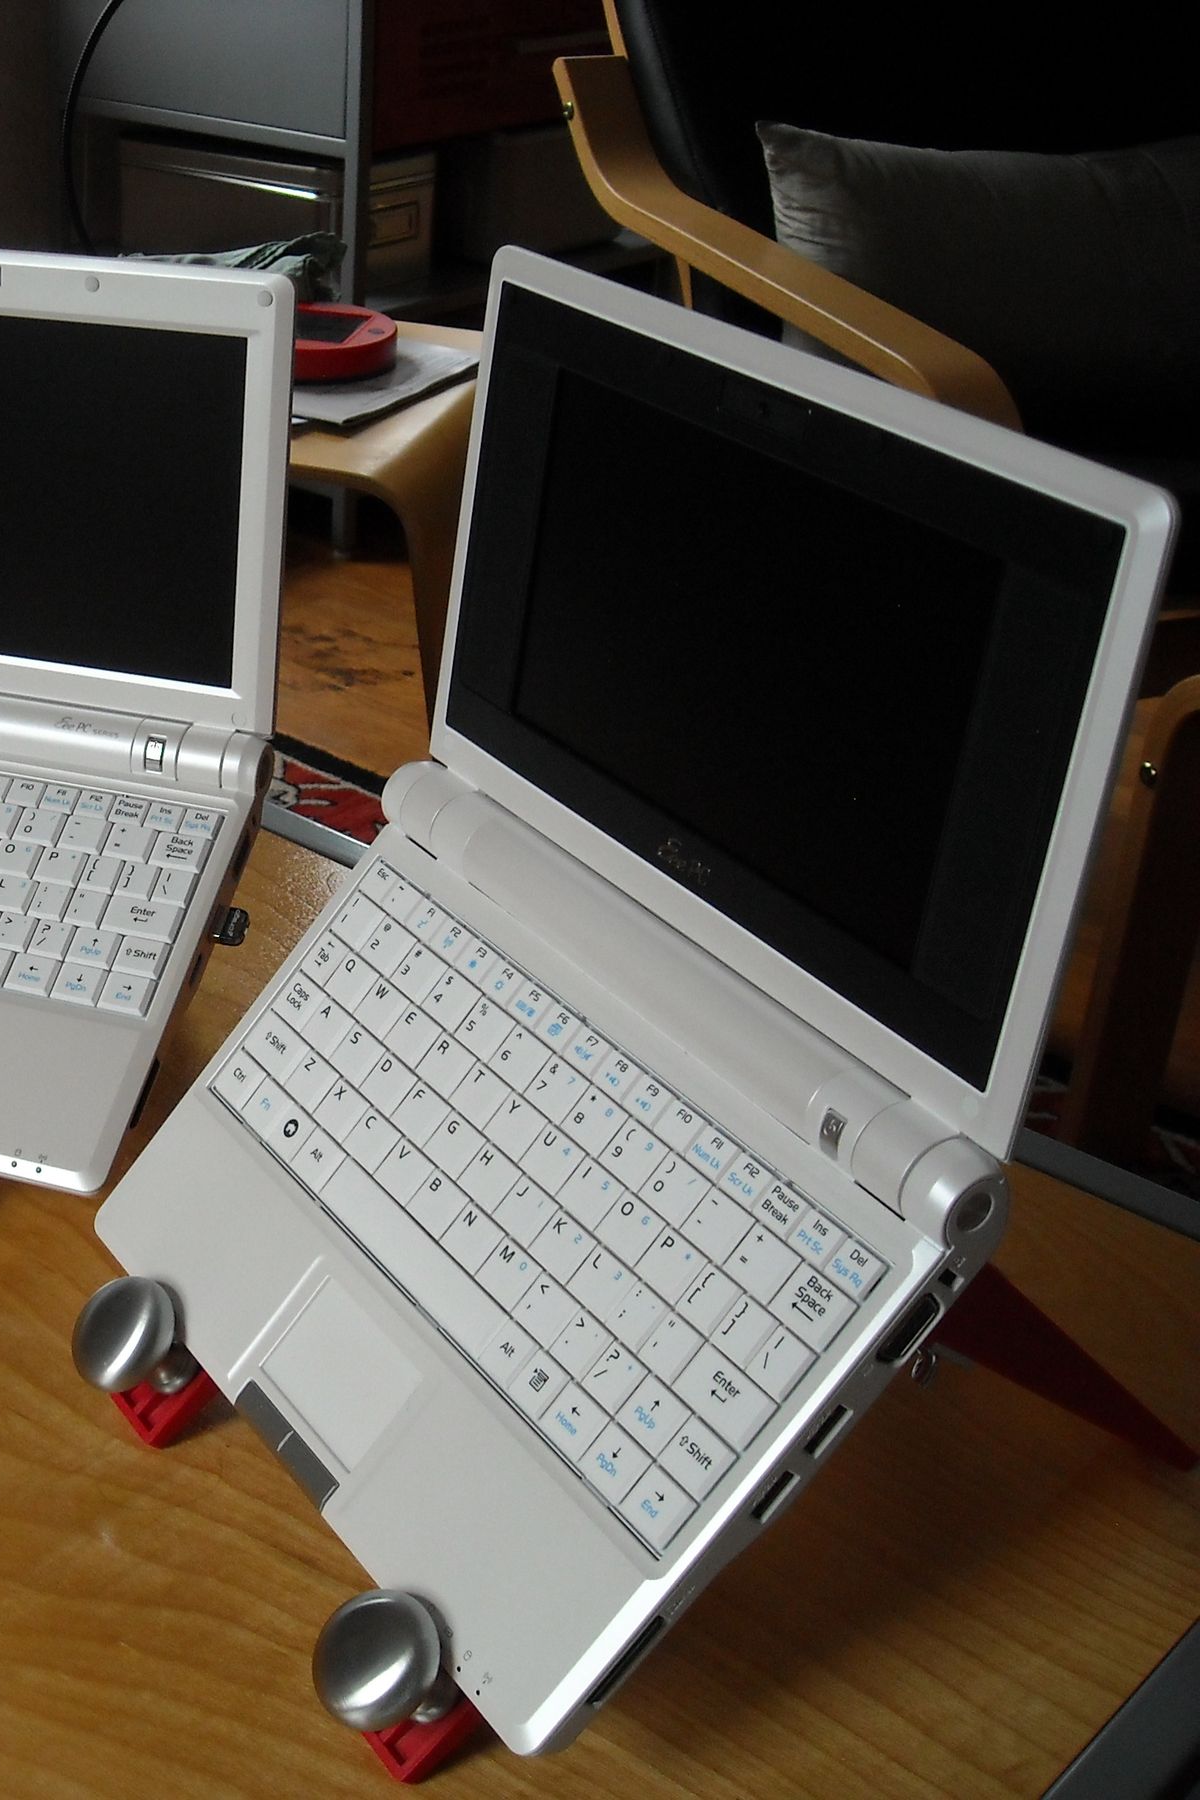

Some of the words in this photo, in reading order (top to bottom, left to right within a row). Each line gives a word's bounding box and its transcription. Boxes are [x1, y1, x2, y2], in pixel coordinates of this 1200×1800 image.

[76, 722, 92, 733] PC
[119, 800, 143, 809] Pause
[115, 809, 138, 818] Break
[5, 844, 15, 853] O
[171, 837, 194, 846] Back
[49, 852, 58, 860] P
[166, 844, 193, 855] Space
[377, 868, 390, 881] Esc
[0, 879, 6, 888] L
[131, 906, 156, 917] Enter
[451, 928, 462, 938] F2
[134, 949, 156, 960] Shift
[316, 948, 329, 963] Tab
[476, 947, 488, 958] F3
[345, 959, 356, 972] Q
[502, 968, 512, 980] F4
[293, 982, 309, 1002] Caps
[375, 984, 390, 999] W
[530, 990, 542, 1002] F5
[286, 992, 302, 1011] Lock
[320, 1005, 331, 1019] A
[405, 1011, 417, 1024] E
[557, 1012, 570, 1024] F6
[466, 1020, 476, 1032] 5
[269, 1035, 287, 1055] Shift
[350, 1031, 362, 1045] S
[585, 1036, 599, 1047] F7
[438, 1041, 449, 1055] R
[501, 1050, 512, 1061] 6
[304, 1058, 316, 1071] Z
[381, 1058, 392, 1072] D
[616, 1060, 629, 1073] F8
[233, 1068, 247, 1083] Ctrl
[473, 1070, 485, 1083] T
[334, 1085, 346, 1100] X
[413, 1089, 425, 1100] F
[646, 1085, 659, 1097] F9
[260, 1098, 271, 1111] Fn
[509, 1100, 520, 1114] Y
[365, 1115, 377, 1128] C
[573, 1112, 585, 1124] 8
[677, 1109, 693, 1124] F10
[447, 1120, 460, 1134] G
[543, 1132, 557, 1147] U
[310, 1148, 323, 1162] Alt
[398, 1146, 410, 1159] V
[480, 1150, 494, 1165] H
[612, 1146, 623, 1157] 9
[743, 1163, 760, 1178] F12
[429, 1178, 442, 1192] B
[516, 1186, 529, 1197] J
[653, 1180, 664, 1192] 0
[772, 1186, 799, 1212] Pause
[621, 1202, 634, 1215] O
[761, 1199, 788, 1225] Break
[463, 1211, 477, 1227] N
[553, 1218, 567, 1234] K
[813, 1220, 829, 1236] Ins
[661, 1236, 674, 1249] P
[499, 1245, 515, 1263] M
[593, 1253, 601, 1269] L
[850, 1249, 868, 1266] Del
[807, 1276, 833, 1302] Back
[795, 1286, 826, 1316] Space
[500, 1341, 515, 1358] Alt
[712, 1370, 741, 1399] Enter
[556, 1411, 578, 1435] Home
[634, 1406, 656, 1430] PgUp
[687, 1442, 714, 1471] Shift
[596, 1453, 617, 1477] PgDn
[641, 1499, 658, 1518] End
